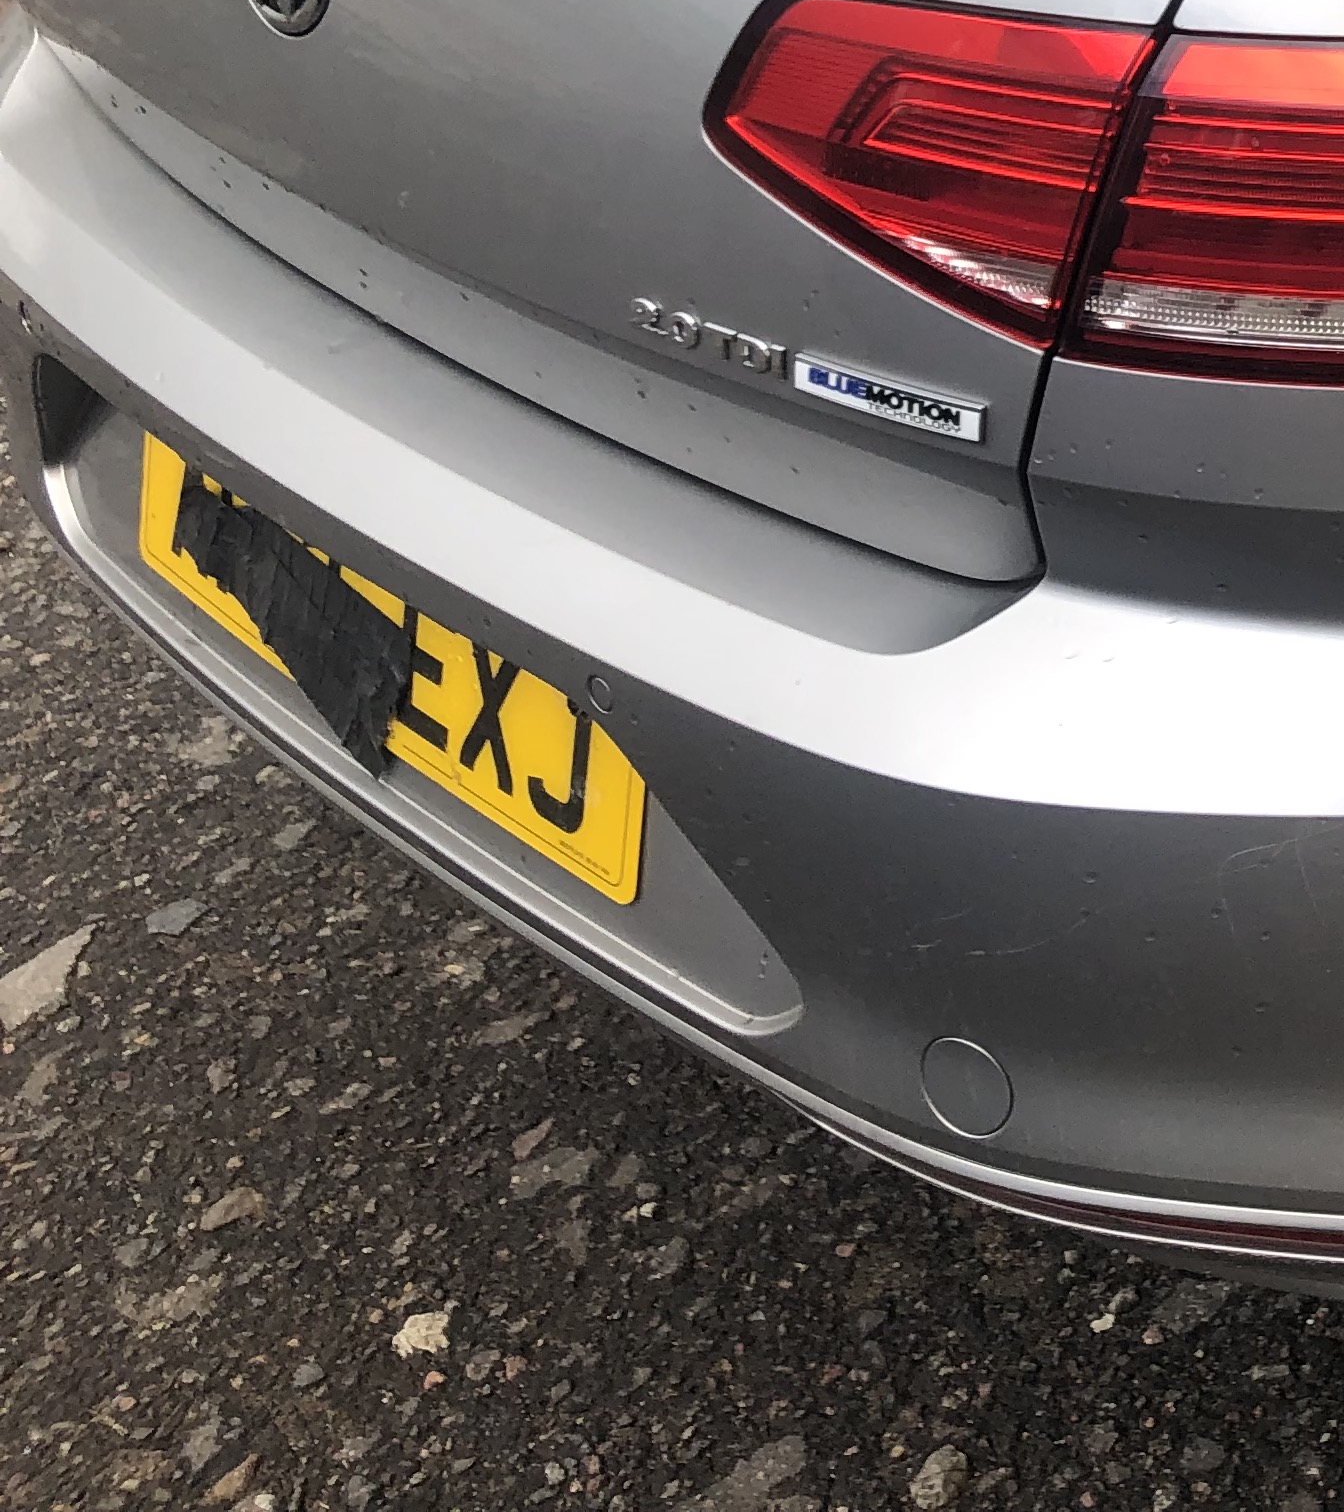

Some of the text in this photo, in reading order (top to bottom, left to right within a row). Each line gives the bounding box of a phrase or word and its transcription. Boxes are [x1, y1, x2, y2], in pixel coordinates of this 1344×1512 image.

[702, 320, 788, 382] TDI
[808, 367, 961, 426] BLUEMOTION
[867, 402, 962, 433] TECHNOLOGY
